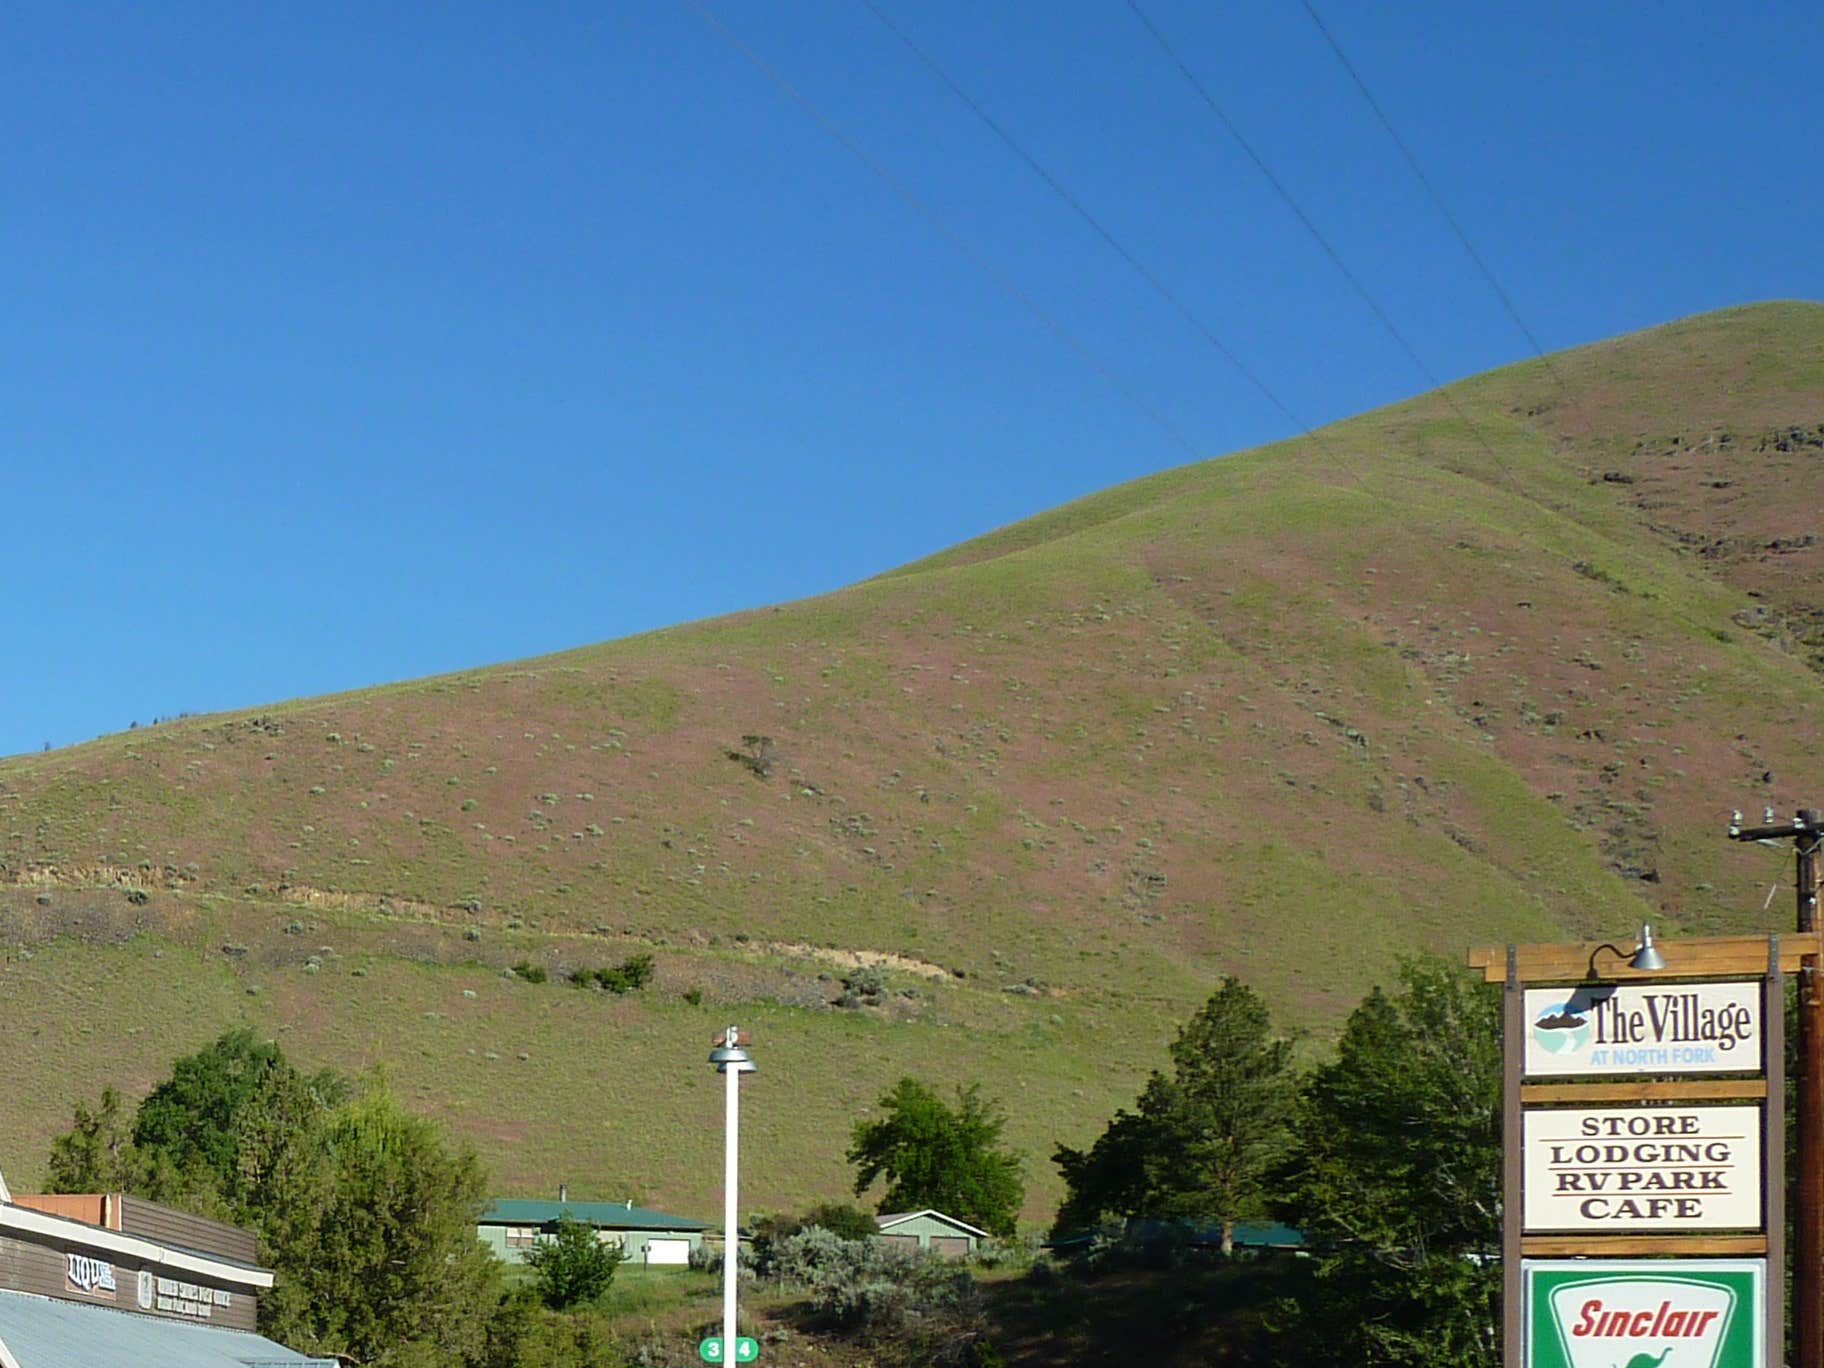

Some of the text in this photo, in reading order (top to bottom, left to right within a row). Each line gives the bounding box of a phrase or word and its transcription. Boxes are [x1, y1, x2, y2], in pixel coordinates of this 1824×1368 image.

[1591, 993, 1753, 1051] The Village
[1590, 1047, 1716, 1066] AT NORTH FORK
[1581, 1115, 1701, 1136] STORE
[1549, 1142, 1732, 1164] LODGING
[1555, 1171, 1728, 1192] RV PARK
[1579, 1198, 1704, 1220] CAFE
[1572, 1299, 1720, 1338] Sinclair
[707, 1341, 751, 1358] 3 4
